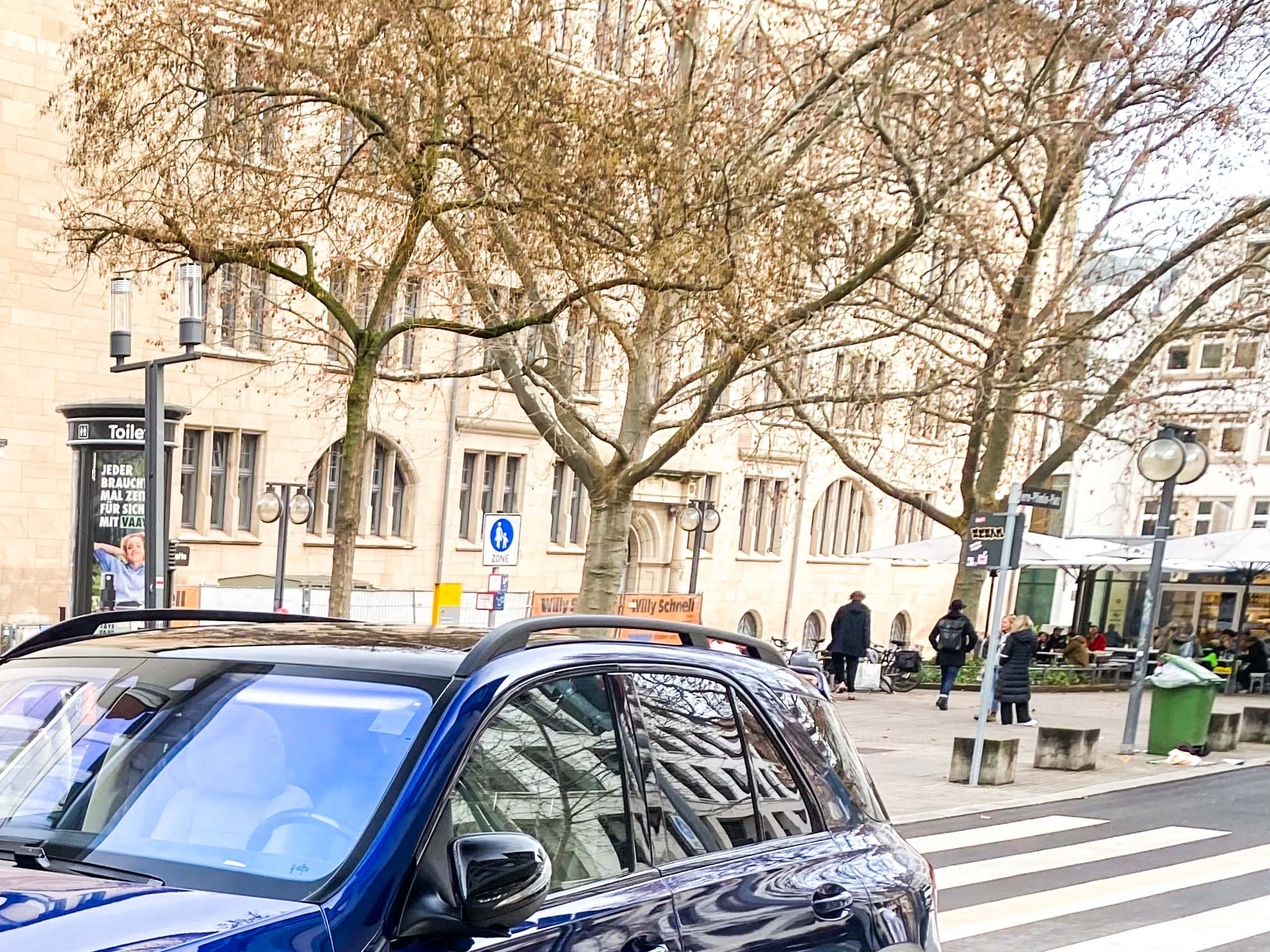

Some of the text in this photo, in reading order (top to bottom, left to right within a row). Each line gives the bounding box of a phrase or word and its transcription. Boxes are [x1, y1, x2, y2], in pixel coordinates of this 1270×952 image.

[108, 424, 145, 440] Toile
[101, 464, 133, 476] JEDER
[100, 477, 145, 489] BRAUCH
[100, 490, 123, 502] MAL
[100, 500, 145, 515] FÜR SICH
[99, 516, 119, 528] MIT
[491, 554, 509, 563] ZONE
[541, 597, 568, 614] Willy
[658, 598, 695, 613] Schnell
